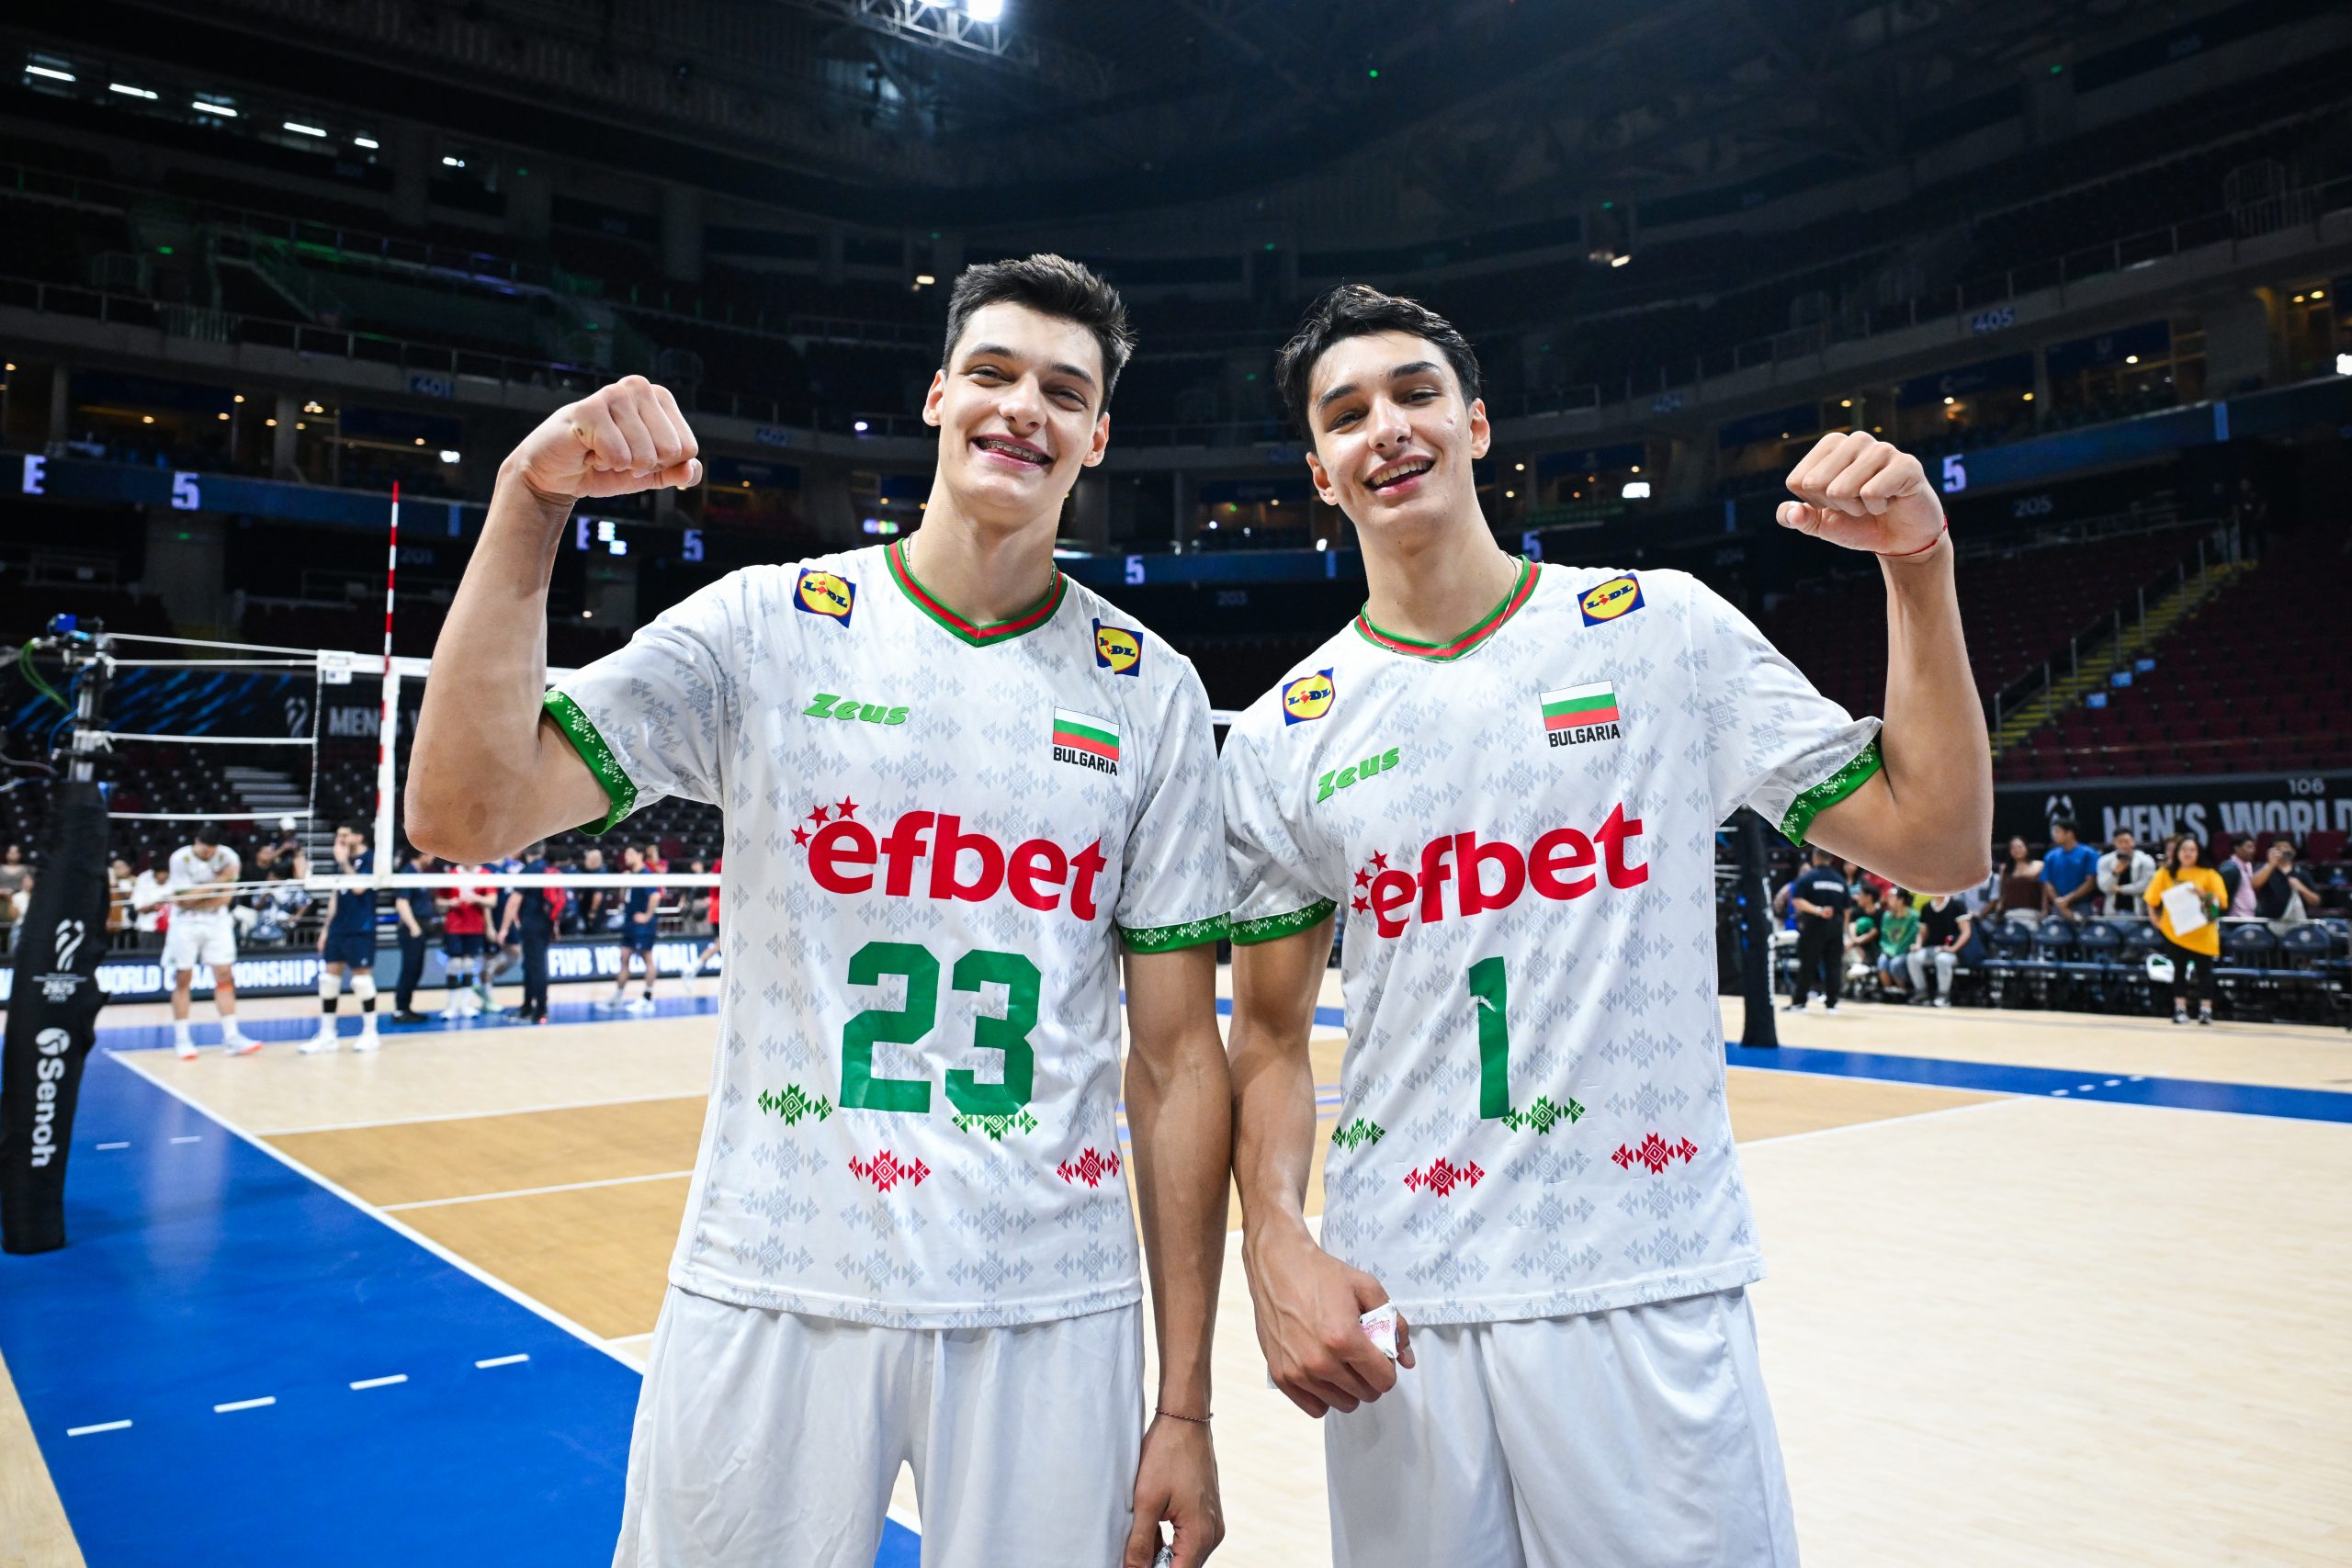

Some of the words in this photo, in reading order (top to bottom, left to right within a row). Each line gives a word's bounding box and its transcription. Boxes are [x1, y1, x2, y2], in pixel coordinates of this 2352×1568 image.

[23, 454, 46, 494] E
[172, 470, 199, 511] 5
[1942, 454, 1966, 493] 5
[2014, 496, 2052, 517] 205
[683, 529, 704, 561] 5
[1521, 530, 1542, 561] 5
[1125, 555, 1145, 585] 5
[803, 694, 910, 726] Zeus
[1549, 724, 1621, 748] BULGARIA
[1053, 747, 1118, 776] BULGARIA
[1317, 748, 1400, 804] Zeus
[2289, 779, 2324, 795] 106
[2102, 803, 2209, 848] MEN'S
[808, 810, 1107, 921] efbet
[1371, 802, 1649, 939] efbet
[95, 965, 161, 993] WORLD
[548, 947, 593, 976] FIVB
[839, 942, 1041, 1116] 23
[1469, 956, 1510, 1120] 1
[31, 1057, 65, 1168] Senoh
